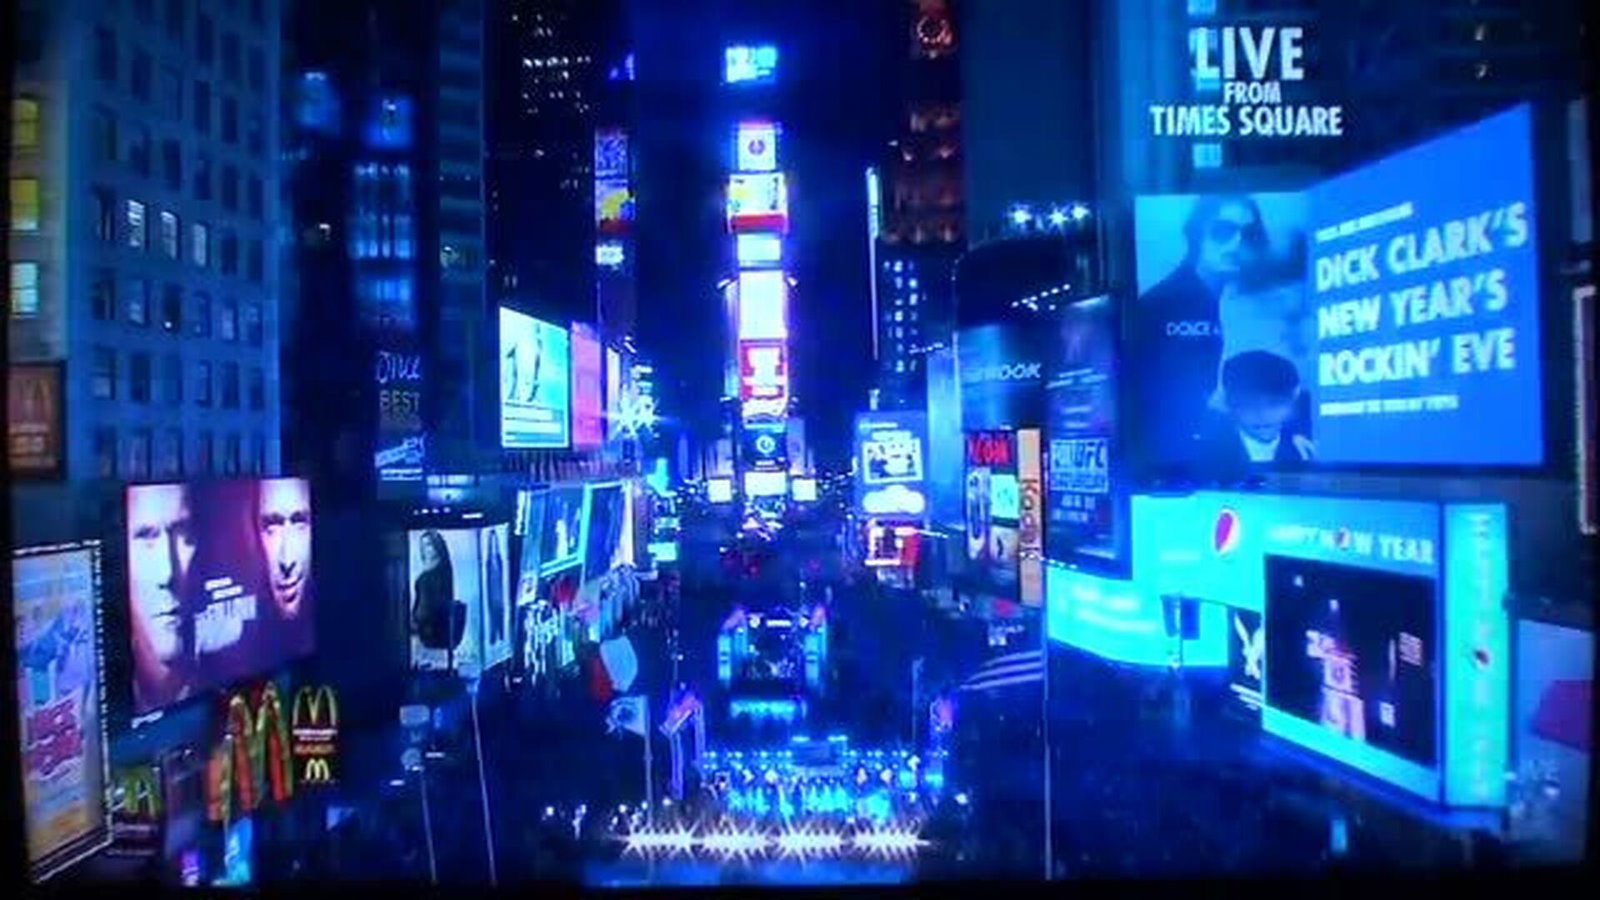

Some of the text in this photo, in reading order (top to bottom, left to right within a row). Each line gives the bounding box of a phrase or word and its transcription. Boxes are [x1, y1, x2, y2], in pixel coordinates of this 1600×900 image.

[1315, 244, 1380, 293] DICK
[1386, 202, 1528, 274] CLARK'S
[1317, 268, 1508, 340] NEW YEAR'S
[1318, 327, 1515, 387] ROCKIN' EVE
[1321, 526, 1373, 556] NW
[1379, 534, 1434, 565] YEAR
